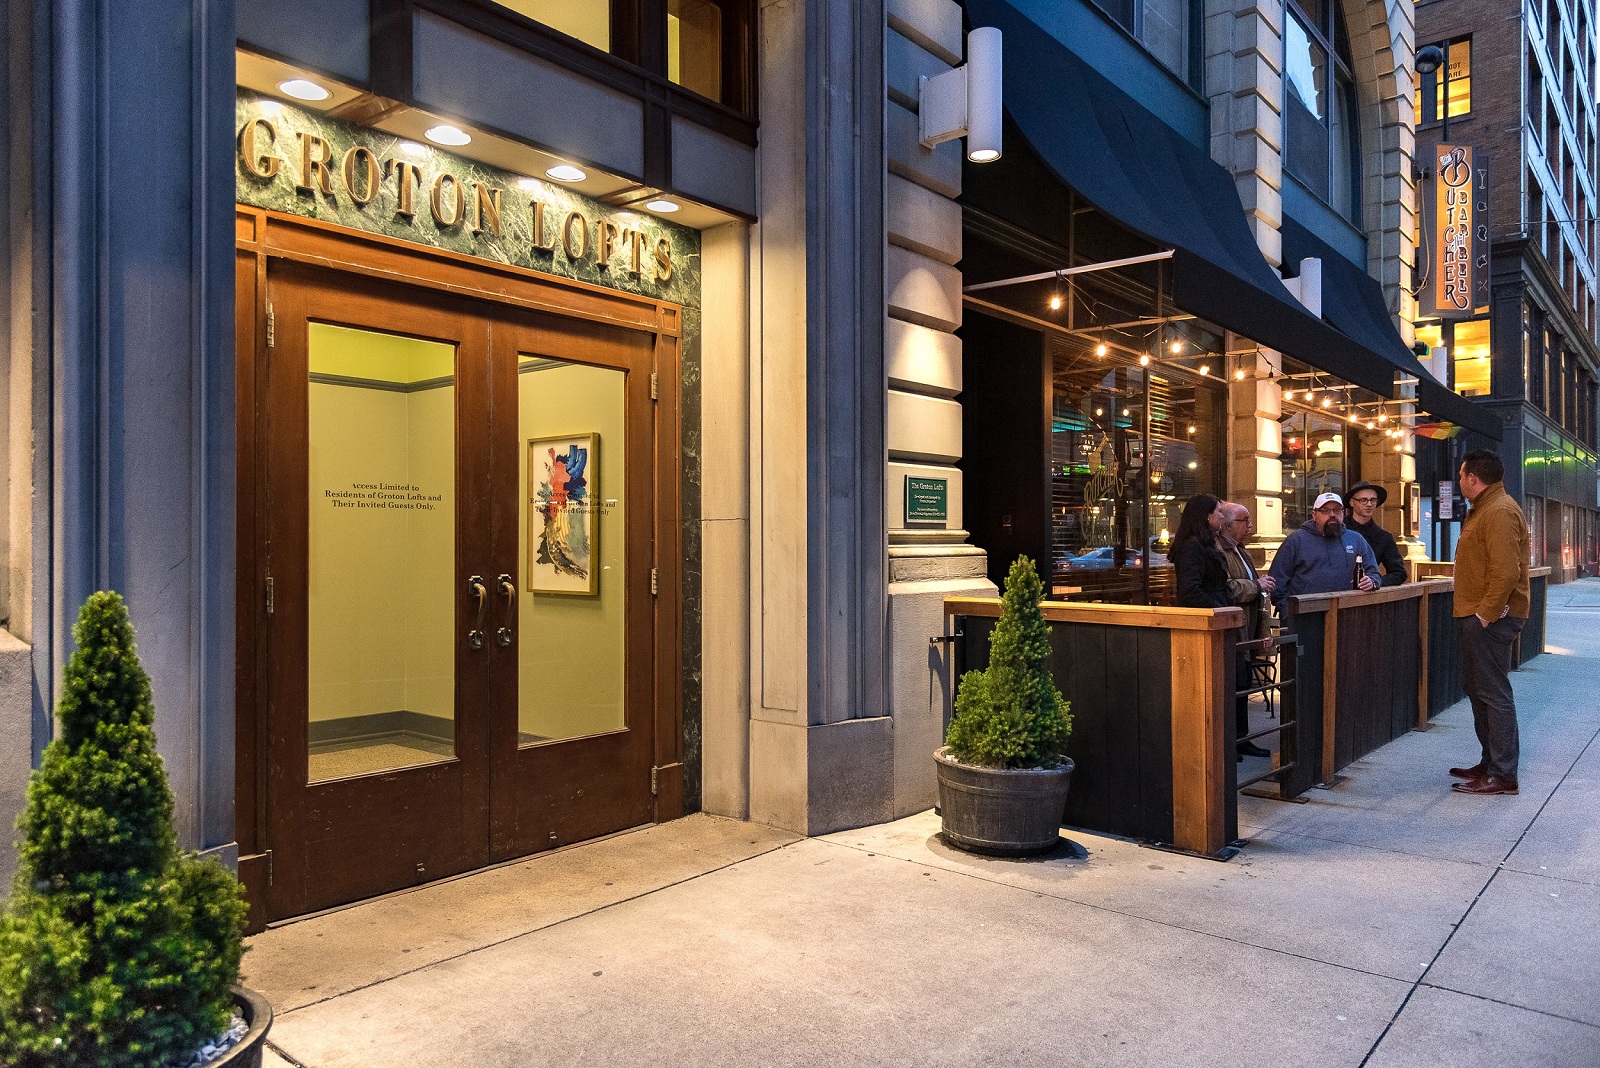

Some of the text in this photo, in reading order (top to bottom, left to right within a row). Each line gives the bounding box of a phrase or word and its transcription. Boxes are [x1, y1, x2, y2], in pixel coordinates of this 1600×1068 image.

[241, 118, 673, 282] GROTON LOFTS
[1440, 147, 1471, 309] BUTCHER
[1458, 191, 1469, 293] BARREL
[325, 490, 366, 499] Residents
[368, 491, 376, 499] of
[377, 492, 405, 500] Groton
[407, 493, 426, 501] Lofts
[332, 500, 436, 511] Their Invited Guests Only.
[379, 483, 409, 491] Limited
